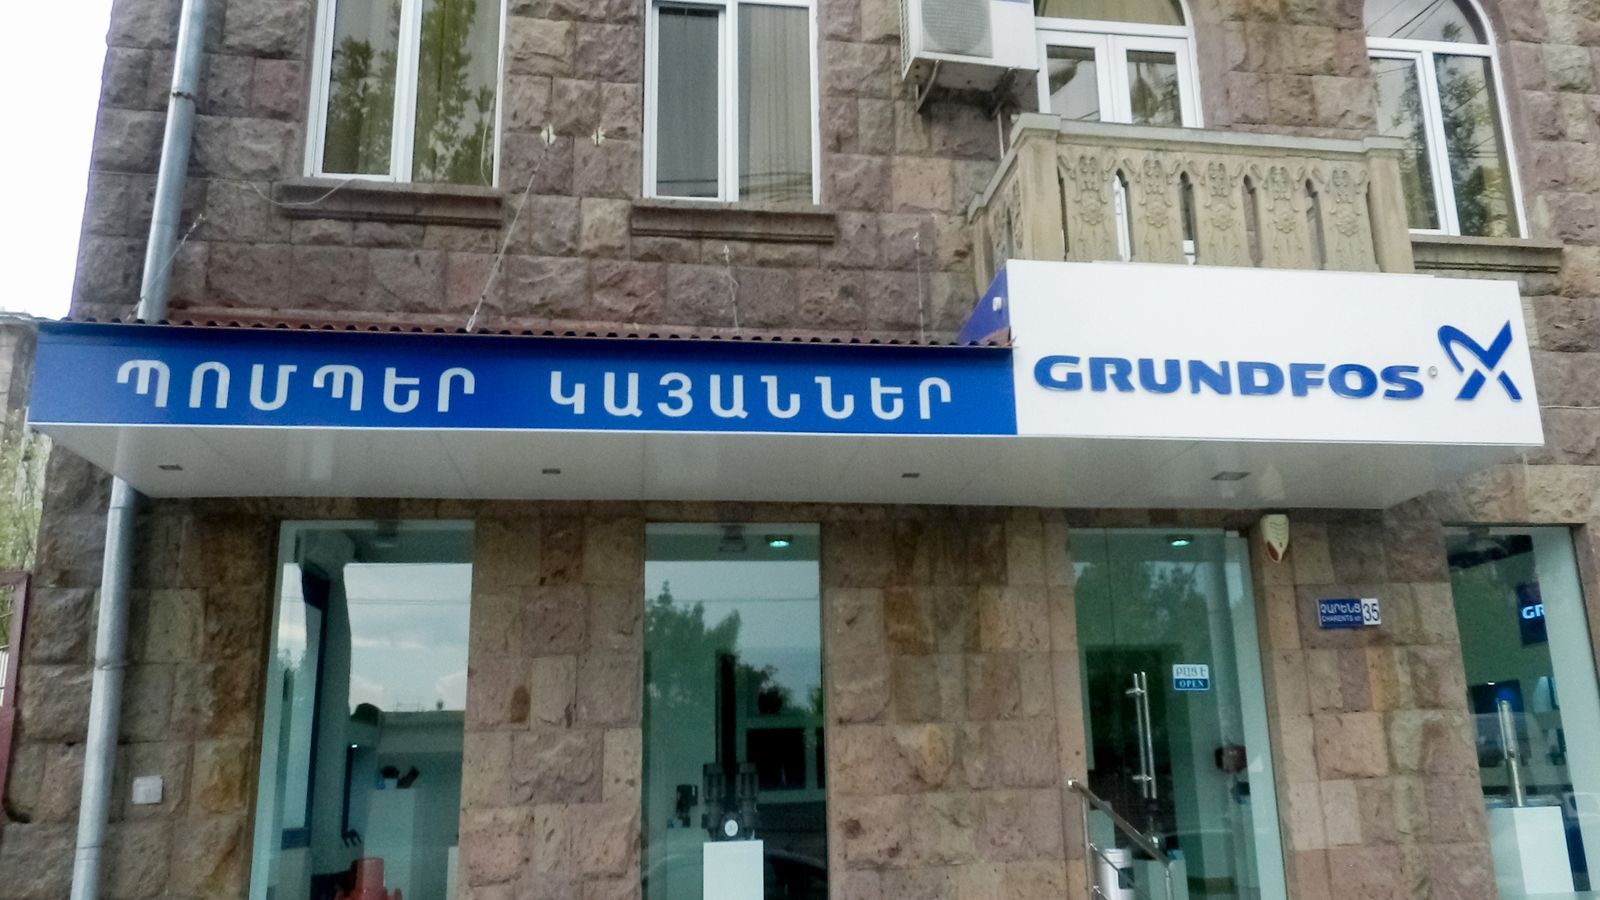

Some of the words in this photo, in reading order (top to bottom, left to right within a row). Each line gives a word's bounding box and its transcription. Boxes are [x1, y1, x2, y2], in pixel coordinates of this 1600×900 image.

[116, 359, 476, 413] ՊՈՄՊԵՐ
[550, 371, 952, 420] ԿԱՅԱՆՆԵՐ
[1034, 355, 1424, 400] GRUNDFOS
[1363, 603, 1380, 621] 35
[1179, 680, 1205, 688] OPEN
